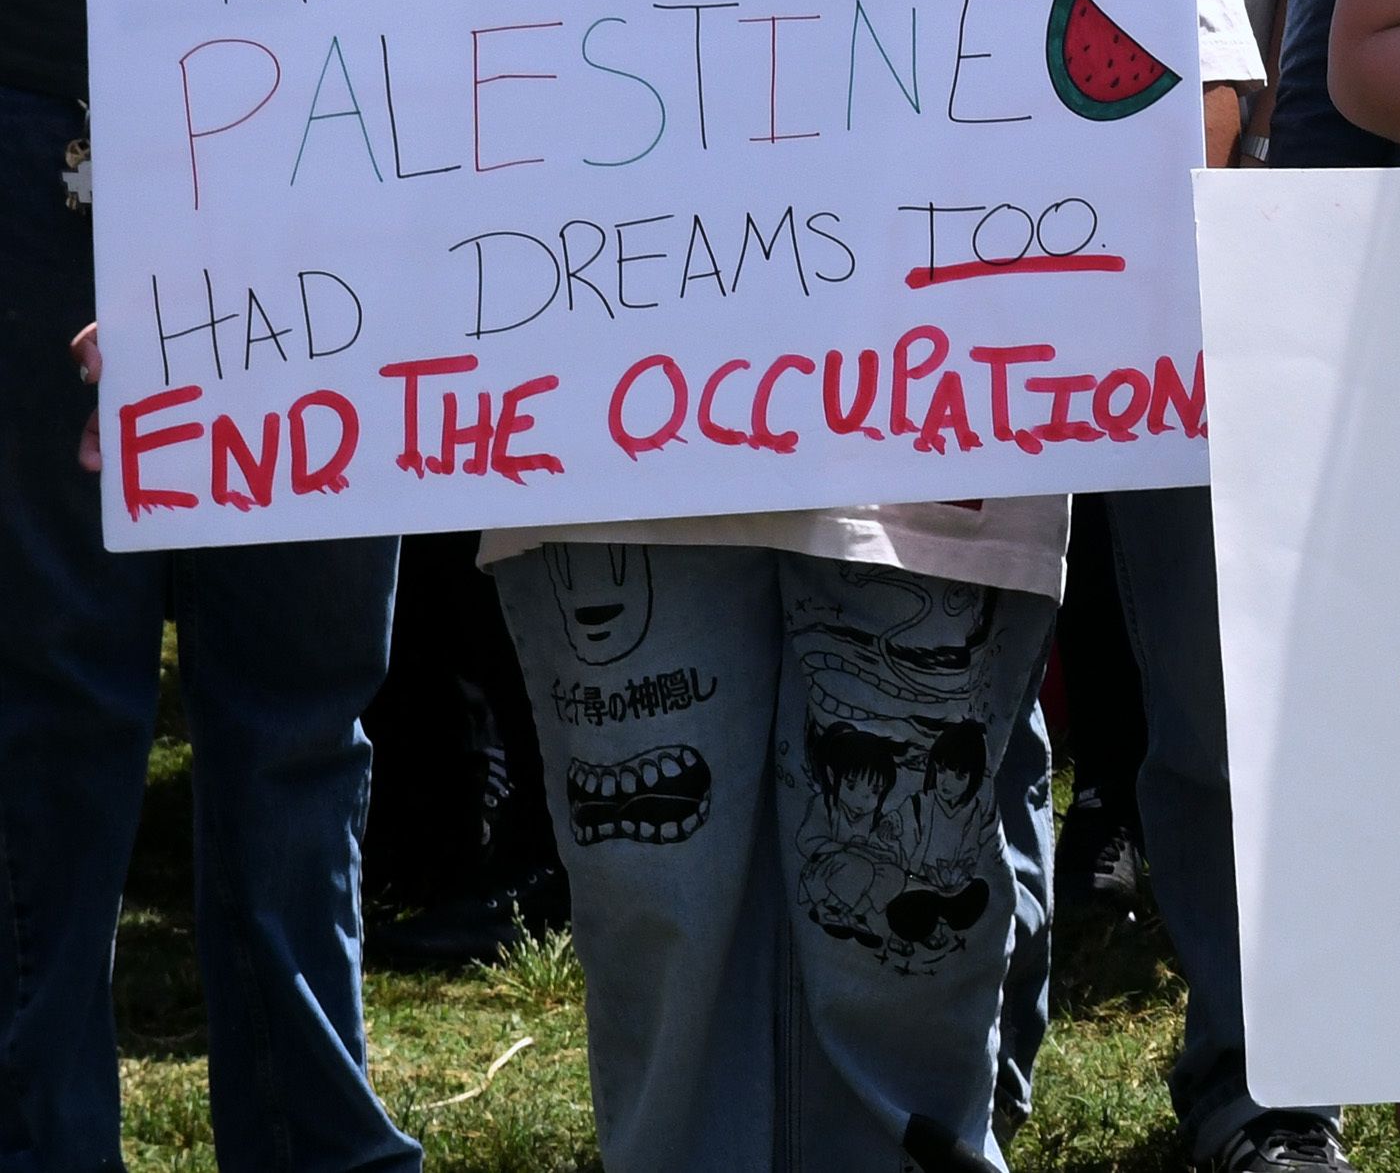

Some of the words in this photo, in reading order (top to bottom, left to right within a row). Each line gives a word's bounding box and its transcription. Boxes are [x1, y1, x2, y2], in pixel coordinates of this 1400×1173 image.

[153, 268, 362, 385] HAD
[449, 206, 856, 339] DREAMS
[119, 384, 360, 522] END
[379, 354, 564, 486] THE
[608, 325, 1208, 462] OCCUPATION
